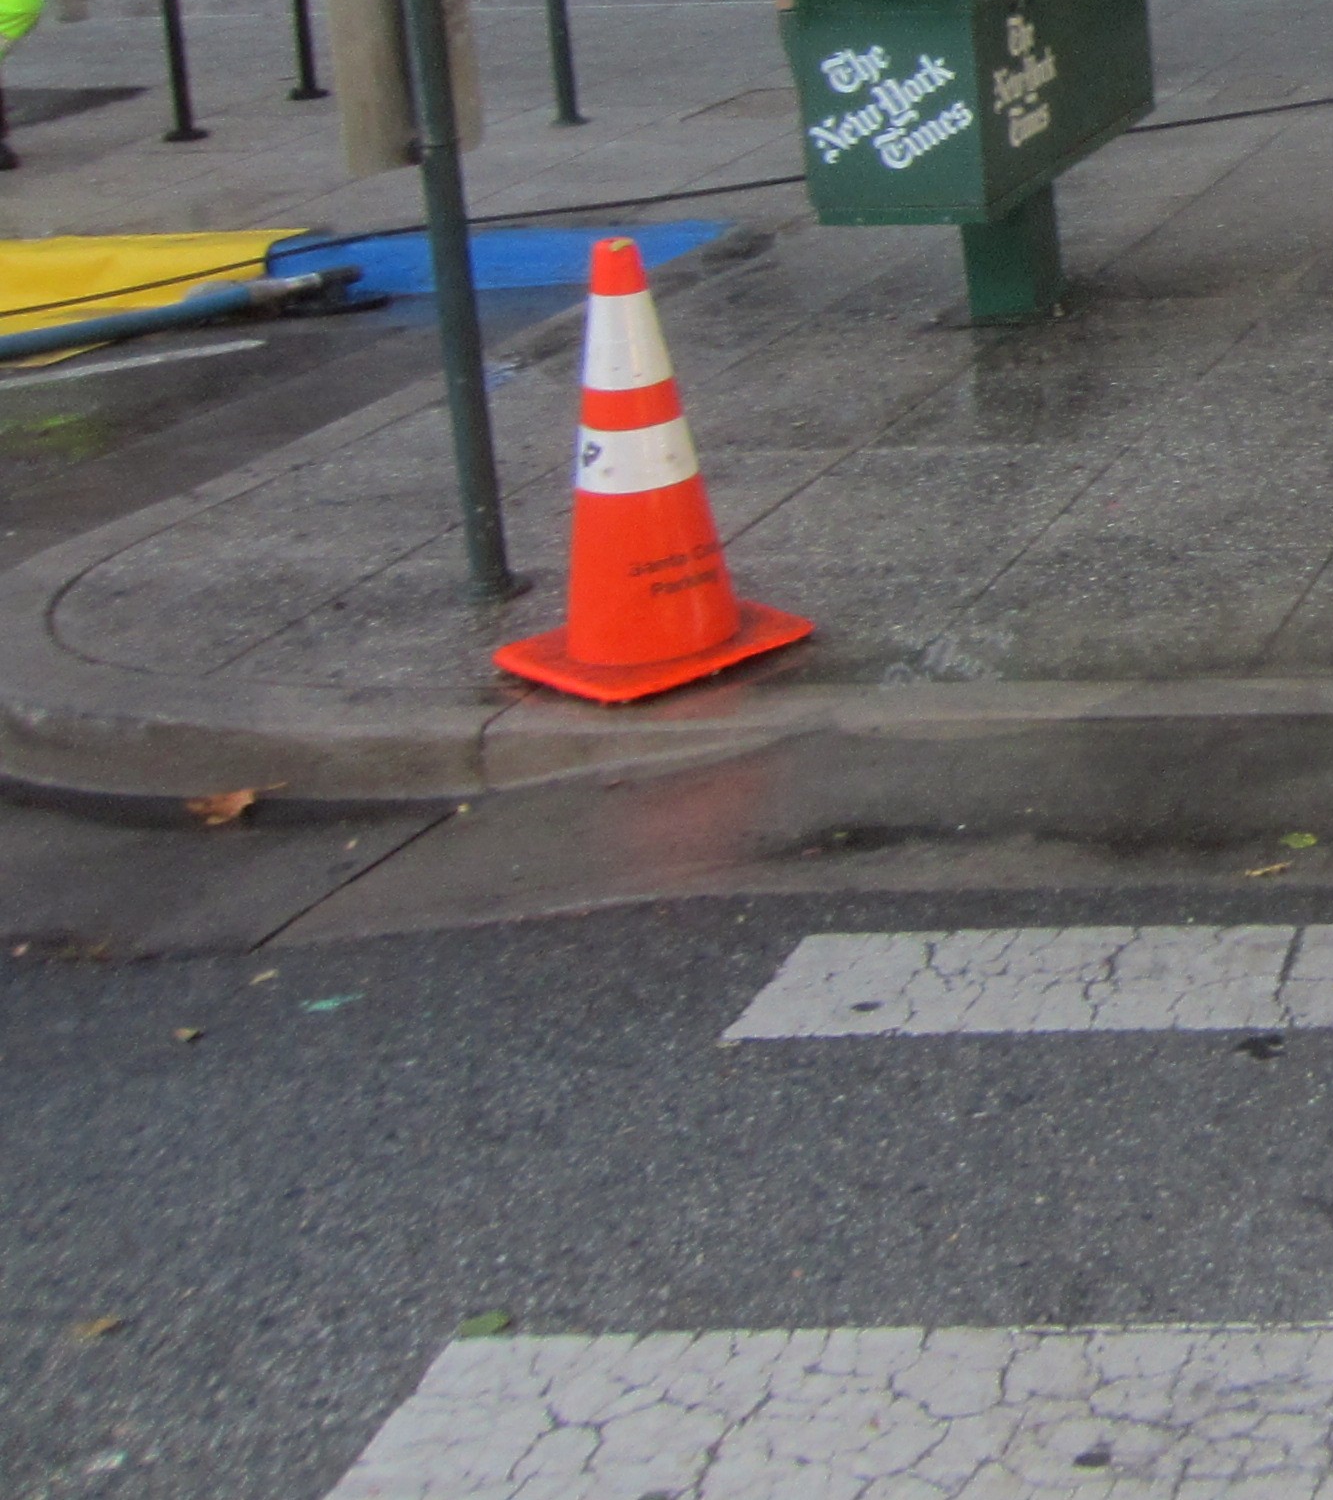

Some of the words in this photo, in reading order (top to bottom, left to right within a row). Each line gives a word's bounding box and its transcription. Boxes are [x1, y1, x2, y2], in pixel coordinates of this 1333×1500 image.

[820, 45, 891, 93] The
[808, 102, 885, 165] New
[869, 53, 956, 127] York
[873, 100, 974, 169] Times
